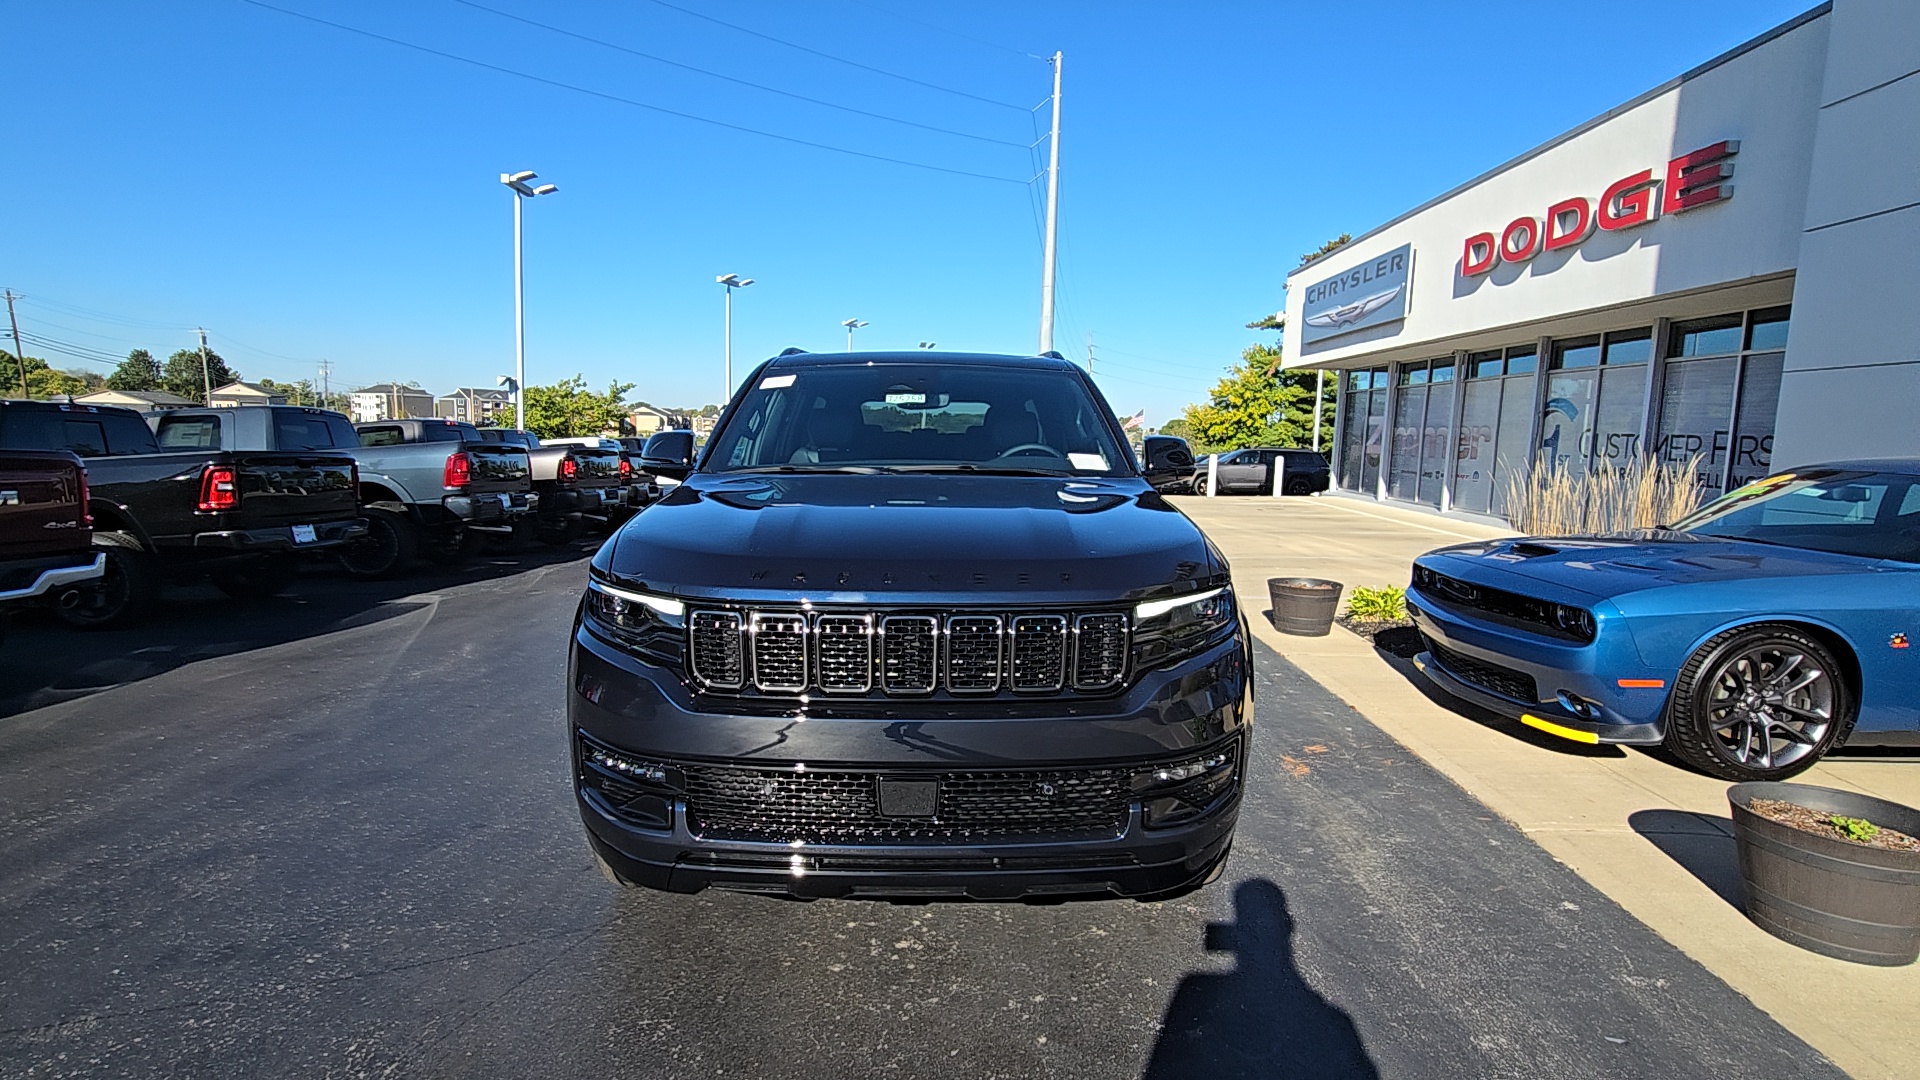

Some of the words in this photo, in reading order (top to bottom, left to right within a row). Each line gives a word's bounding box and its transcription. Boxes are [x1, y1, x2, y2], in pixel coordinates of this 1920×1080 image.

[1463, 140, 1741, 277] DODGE
[1308, 254, 1403, 304] CHRYSLER
[1366, 415, 1491, 460] Zmmer
